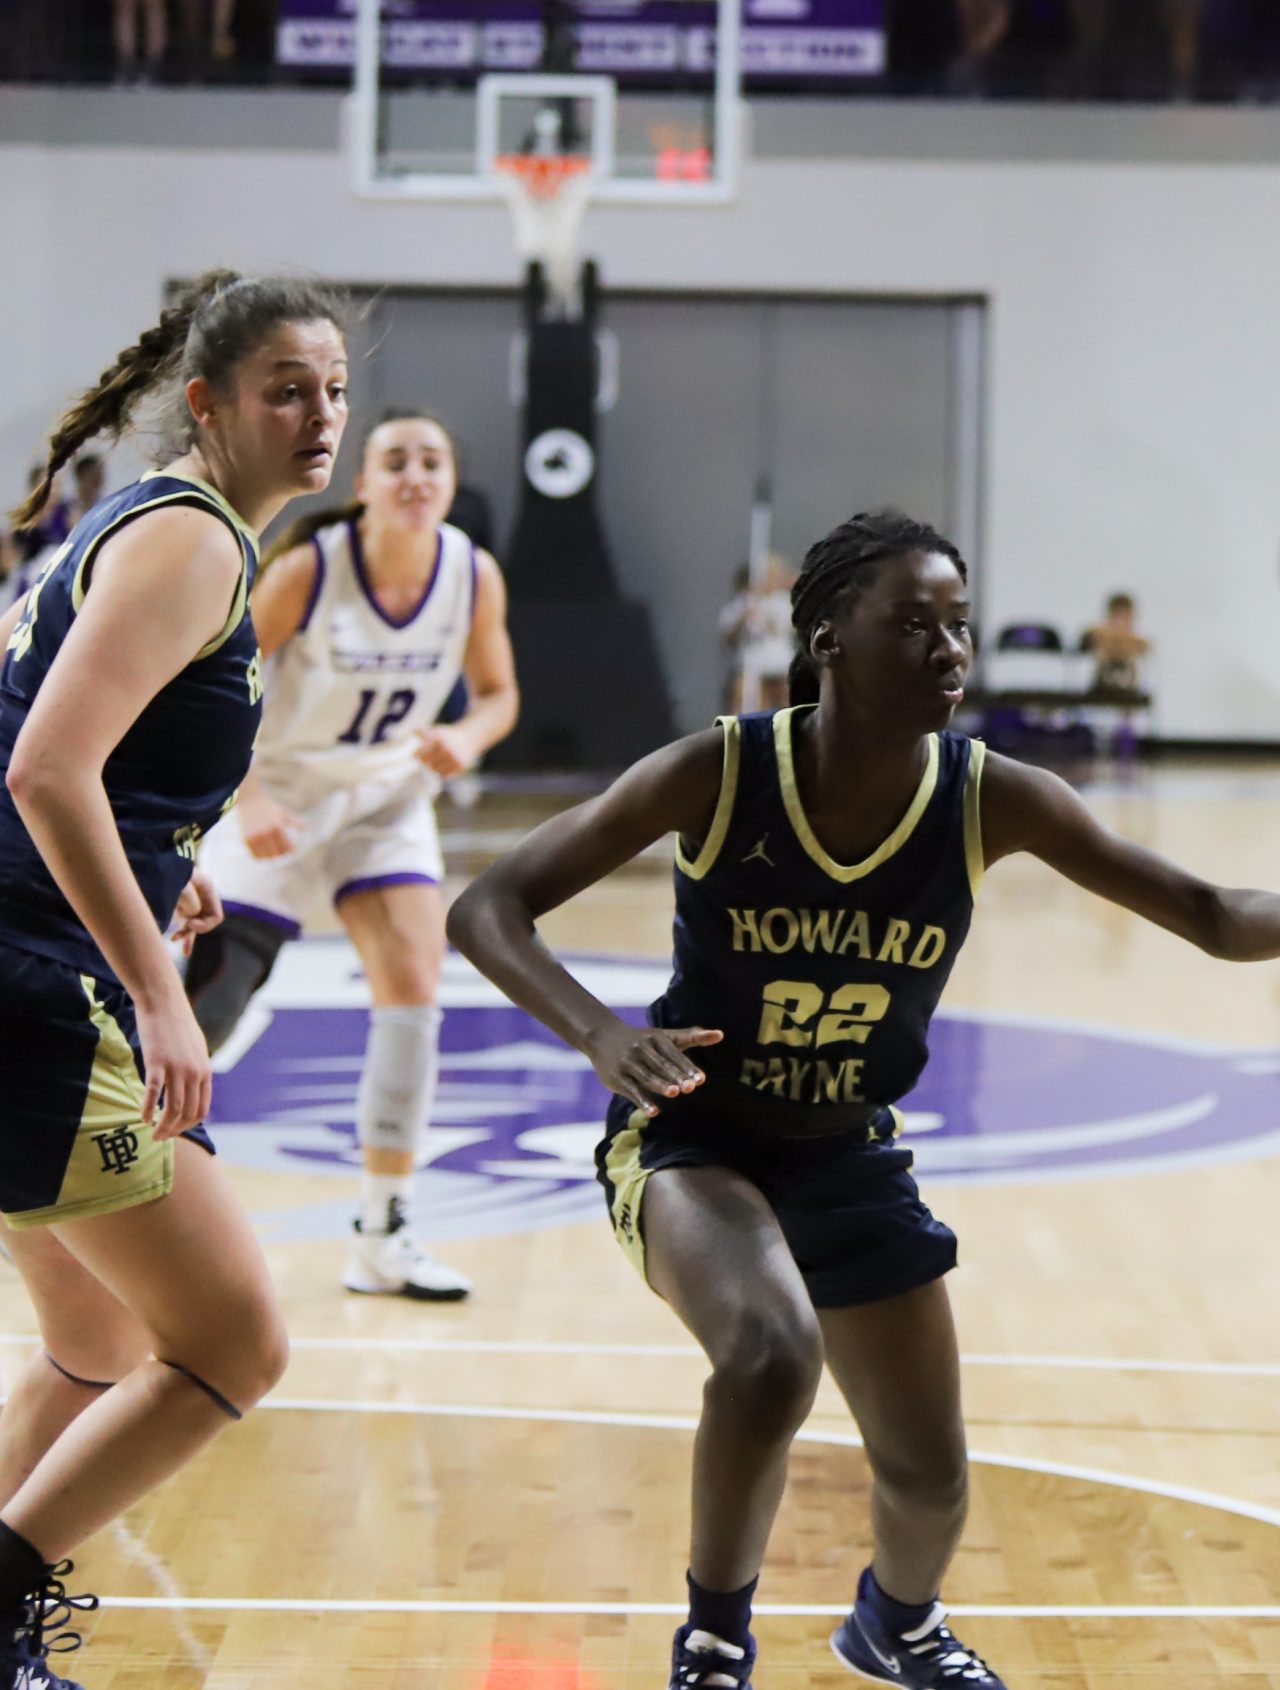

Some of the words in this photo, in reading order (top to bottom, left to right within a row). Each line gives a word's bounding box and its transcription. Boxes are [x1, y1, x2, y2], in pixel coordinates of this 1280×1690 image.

[337, 688, 416, 744] 12
[726, 907, 946, 969] HOWARD
[758, 980, 891, 1049] 22
[740, 1056, 866, 1103] PAYNE
